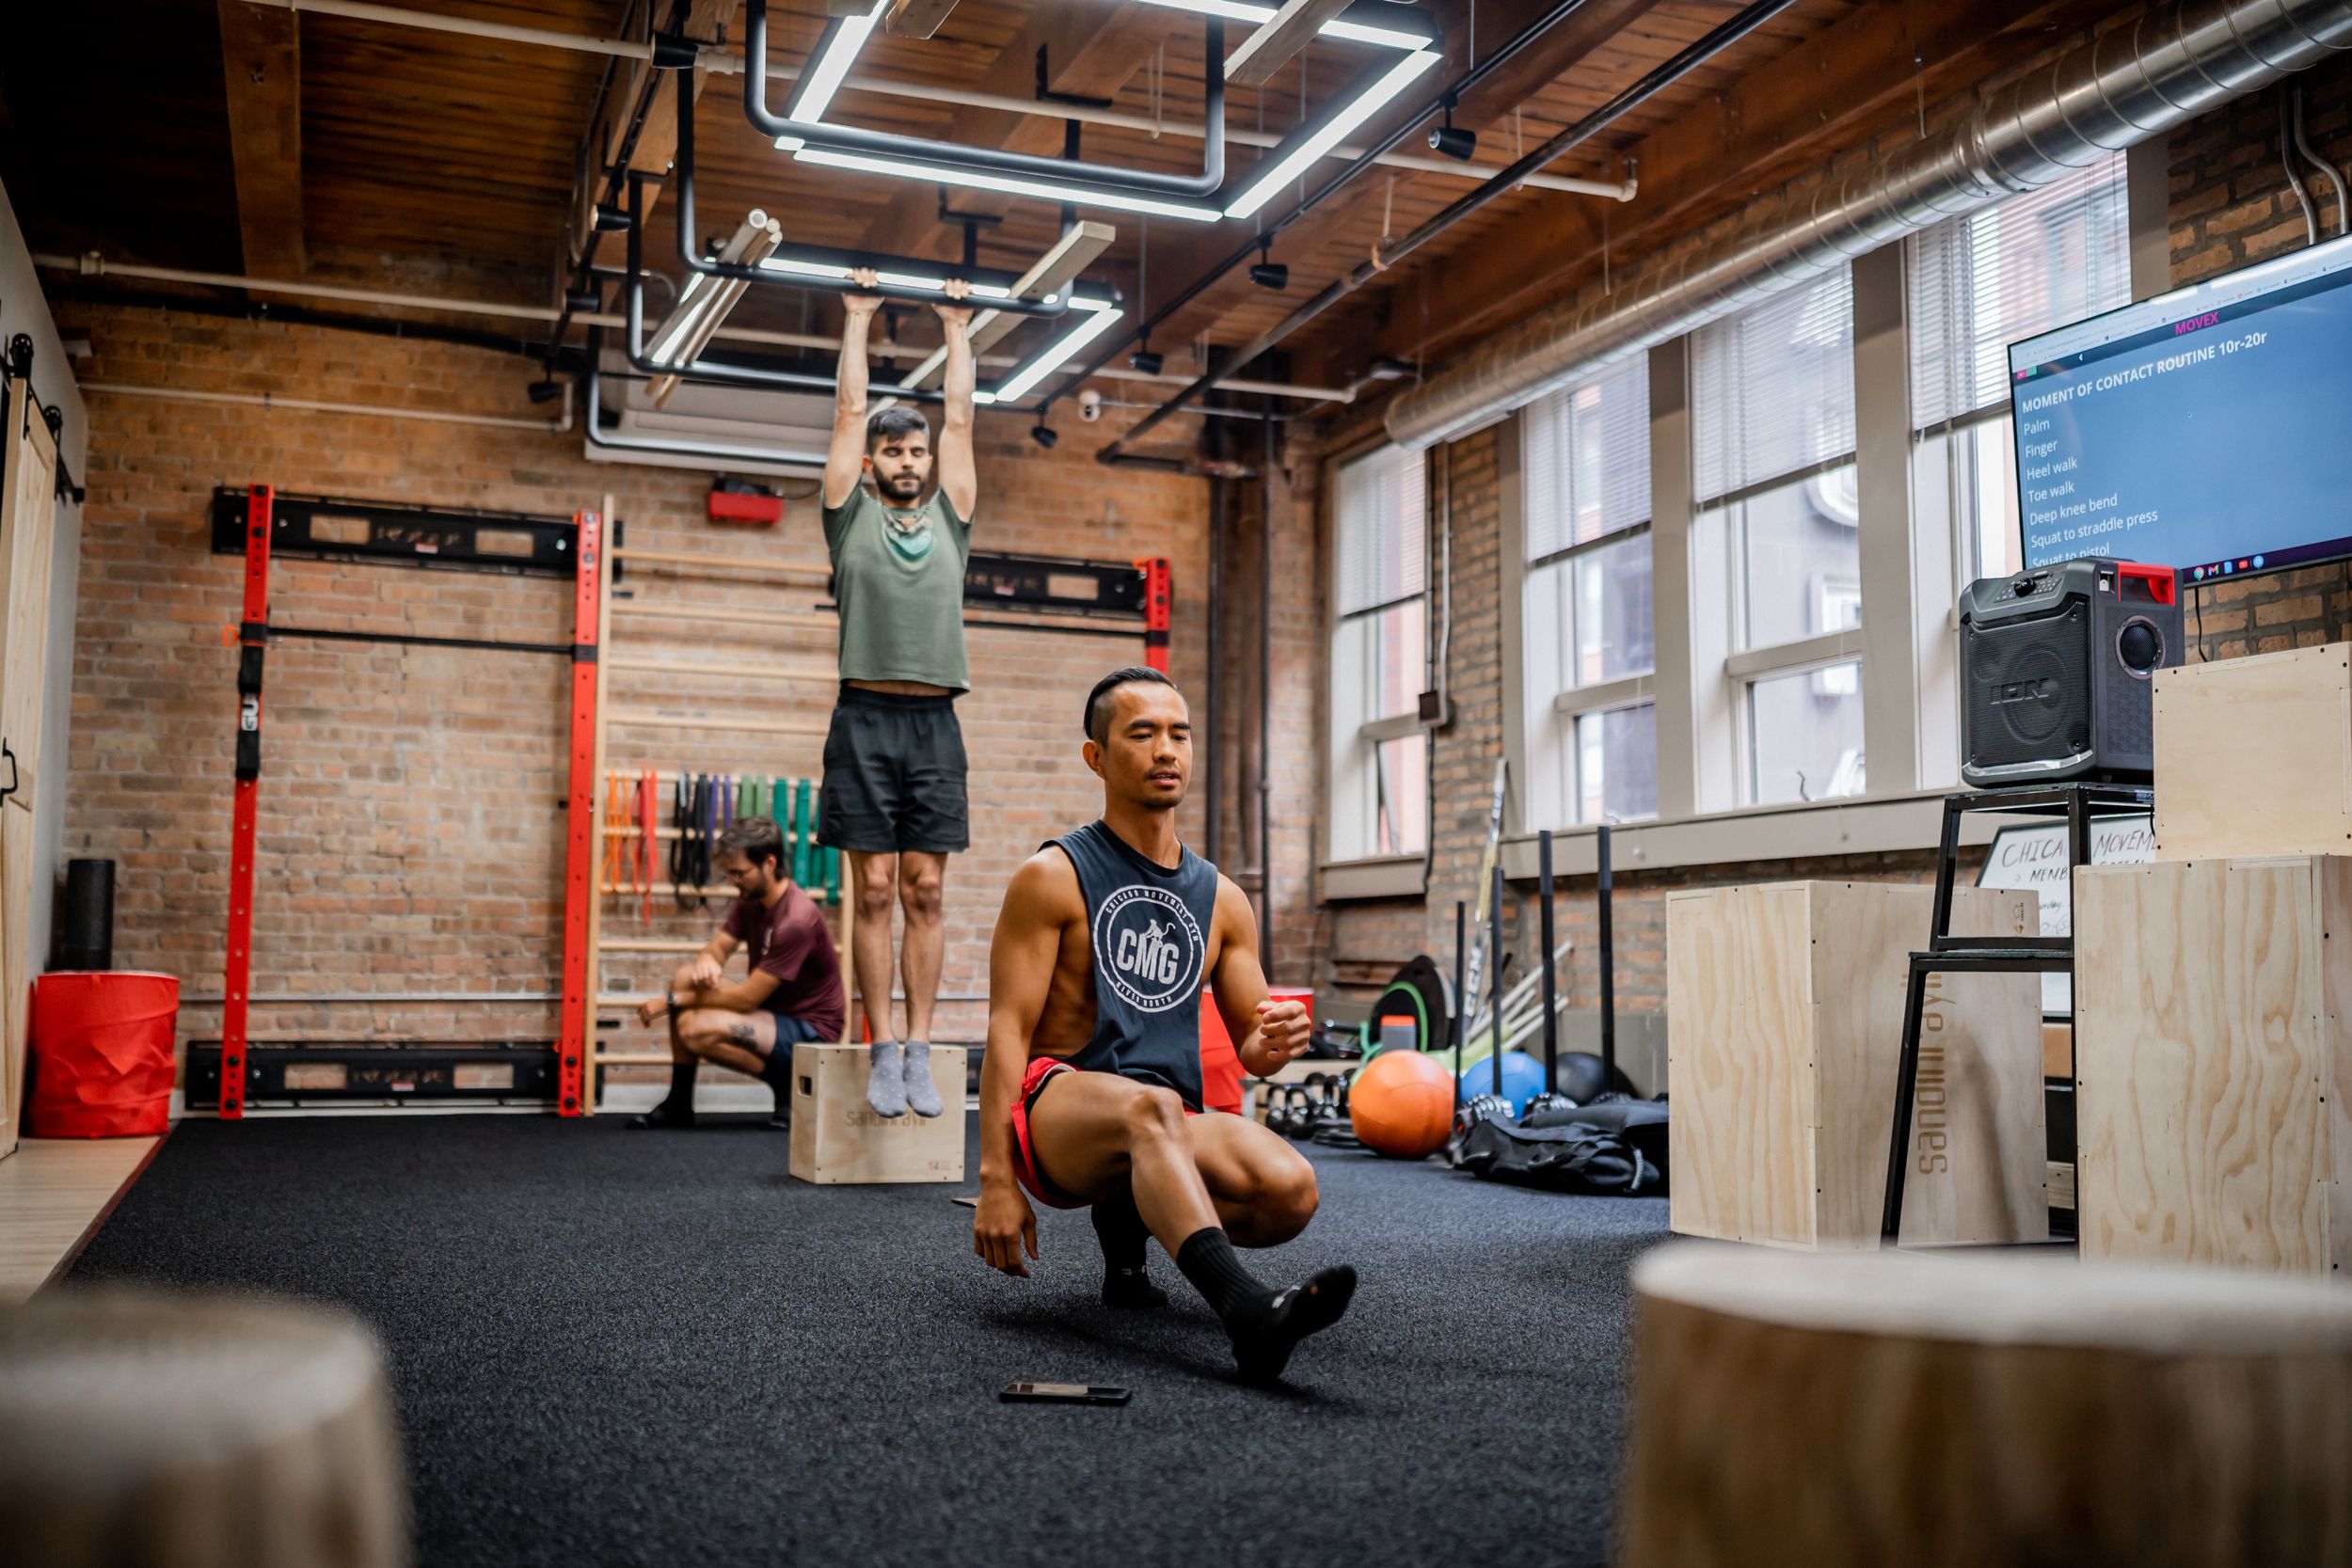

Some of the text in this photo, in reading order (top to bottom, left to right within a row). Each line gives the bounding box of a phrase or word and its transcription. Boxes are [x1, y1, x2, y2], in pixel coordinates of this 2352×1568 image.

[2175, 311, 2219, 335] MOVEX
[2022, 332, 2267, 414] MOMENT OF CONTACT ROUTINE 10r-20r
[2024, 420, 2050, 436] Palm
[2025, 440, 2058, 458] Finger
[2026, 456, 2078, 481] Heel walk
[2027, 481, 2074, 503] Toe walk
[2029, 493, 2118, 526] Deep knee bend
[2030, 511, 2158, 549] Squat to straddle press
[2065, 551, 2077, 562] to
[2001, 830, 2156, 868] CHICA MOVEM
[1104, 889, 1139, 914] CHICAGO
[1144, 890, 1187, 919] MOVEMENT
[1116, 928, 1180, 985] CMG
[1116, 980, 1172, 1007] RIVER NORTH
